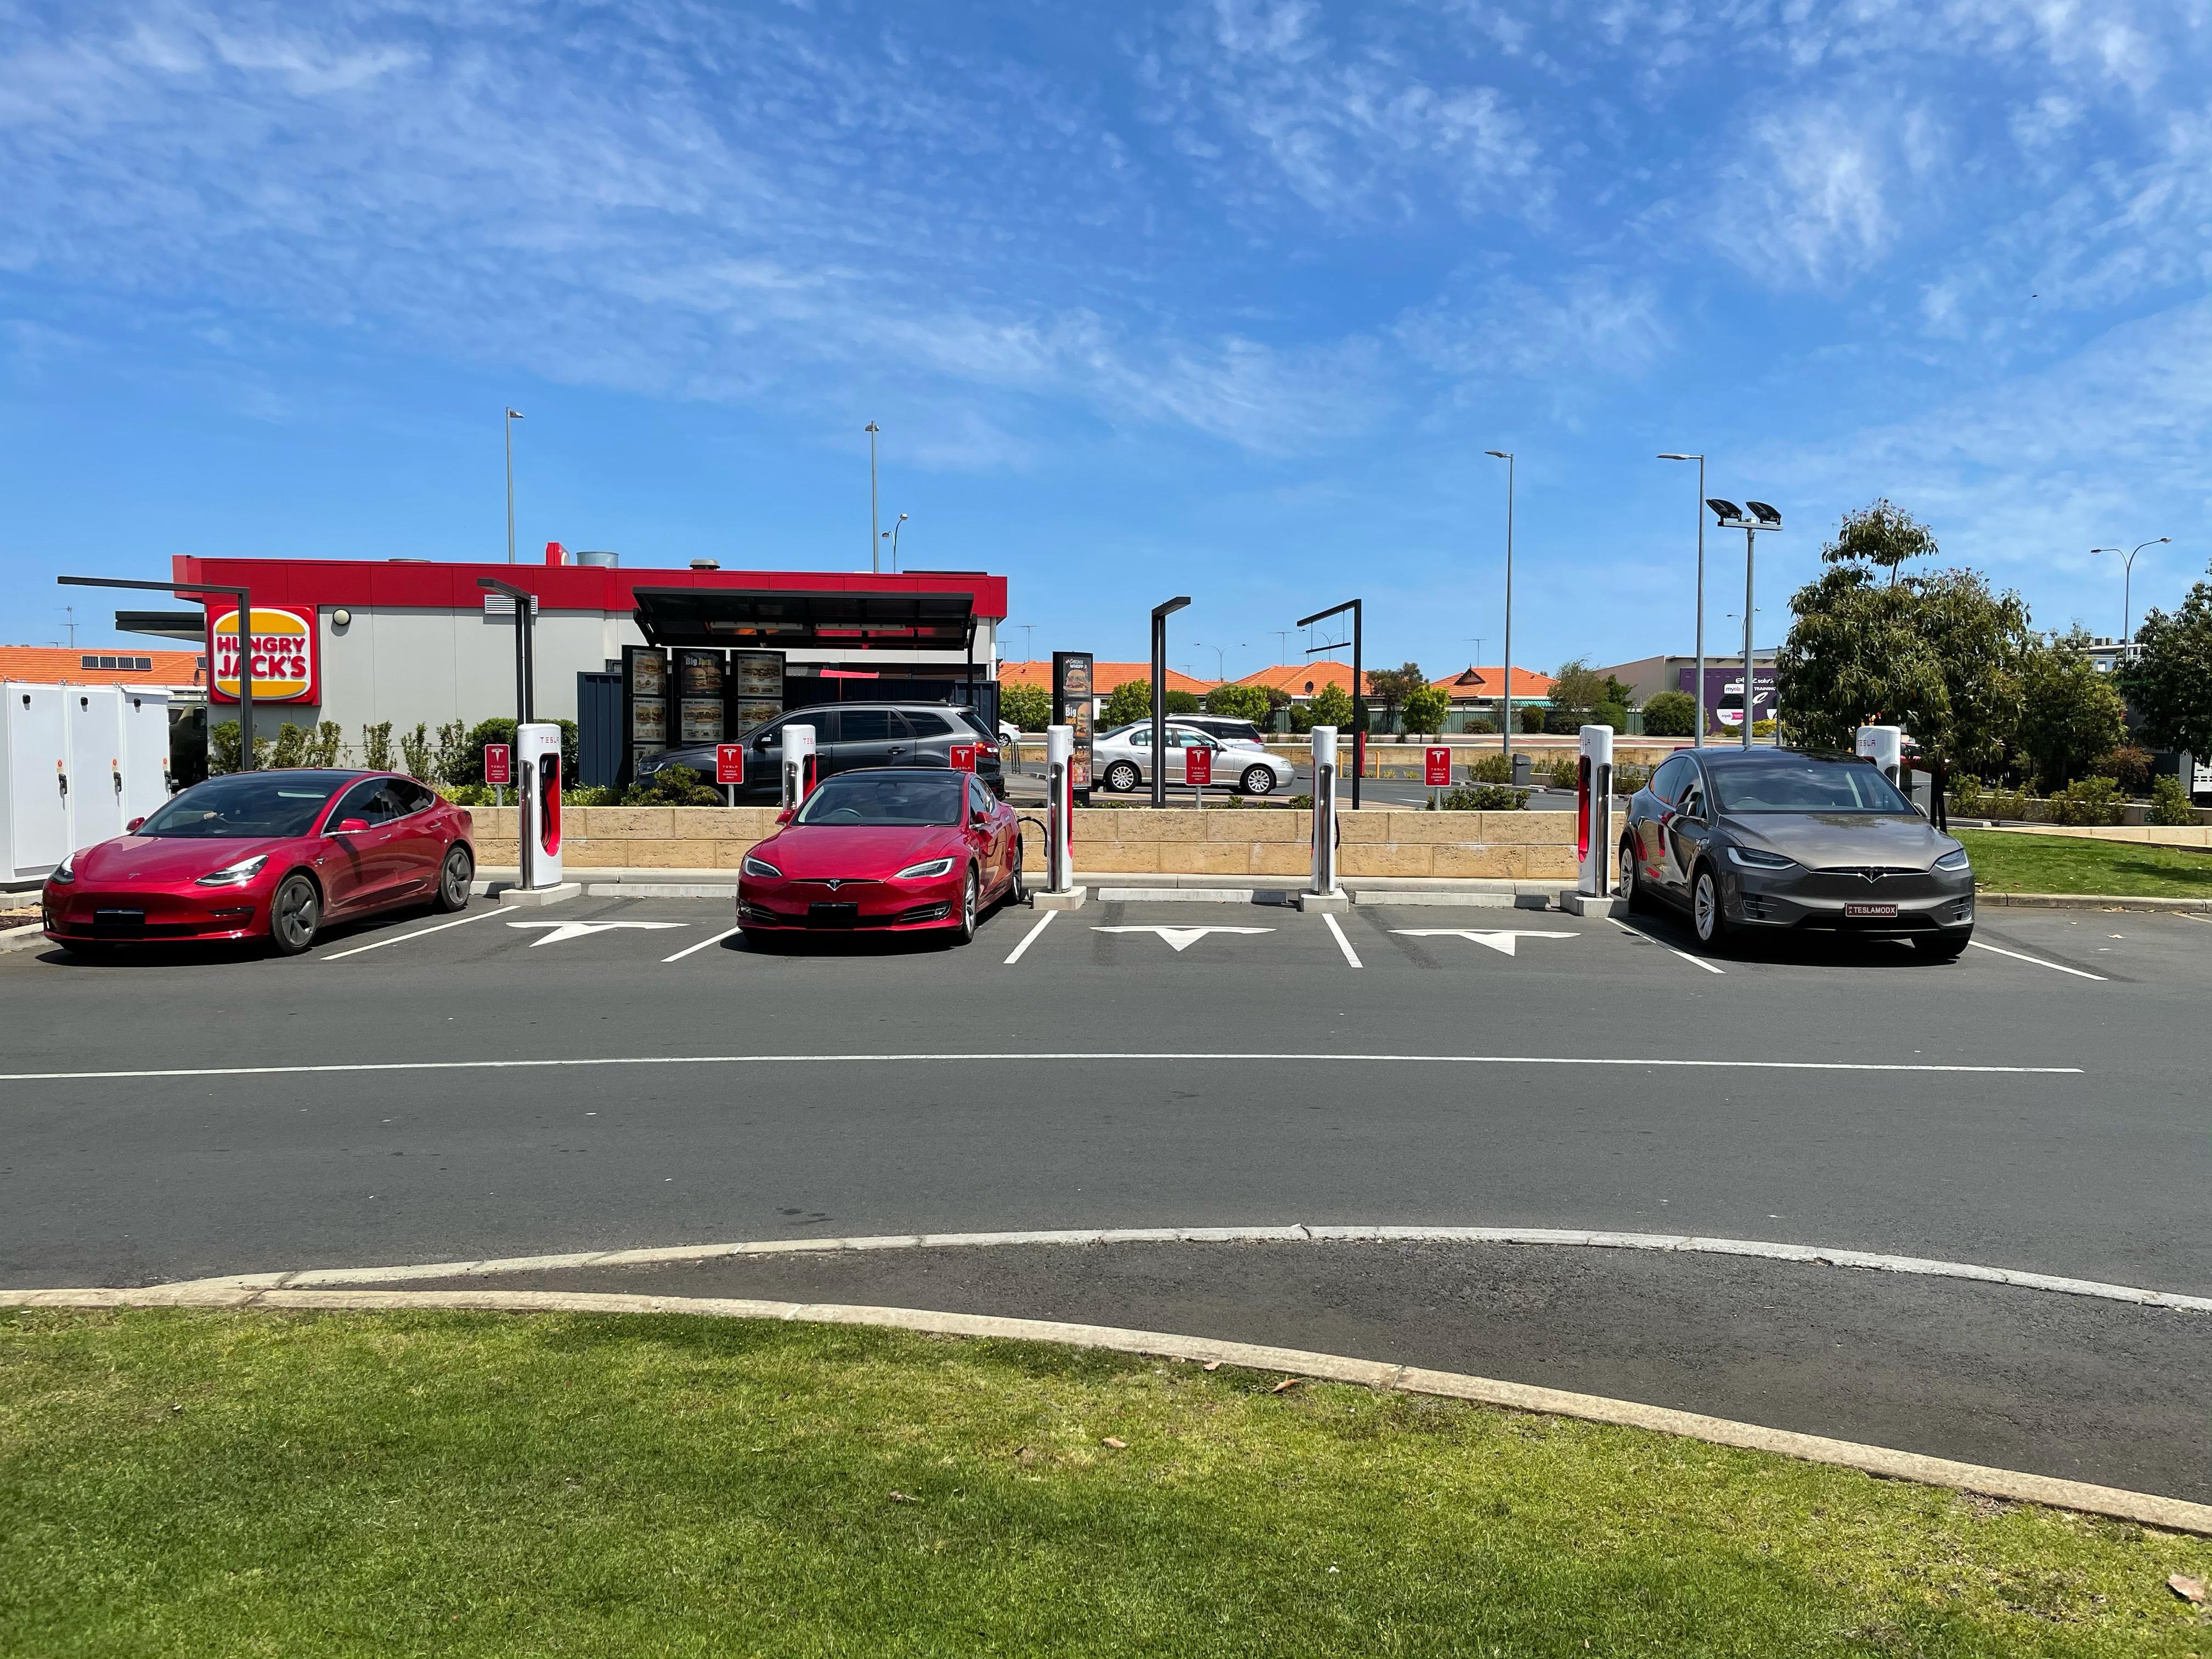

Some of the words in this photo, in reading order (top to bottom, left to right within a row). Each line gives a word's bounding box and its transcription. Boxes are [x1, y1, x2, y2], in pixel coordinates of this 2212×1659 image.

[686, 657, 697, 666] Big
[1065, 707, 1076, 718] Big
[1065, 716, 1076, 724] Jack
